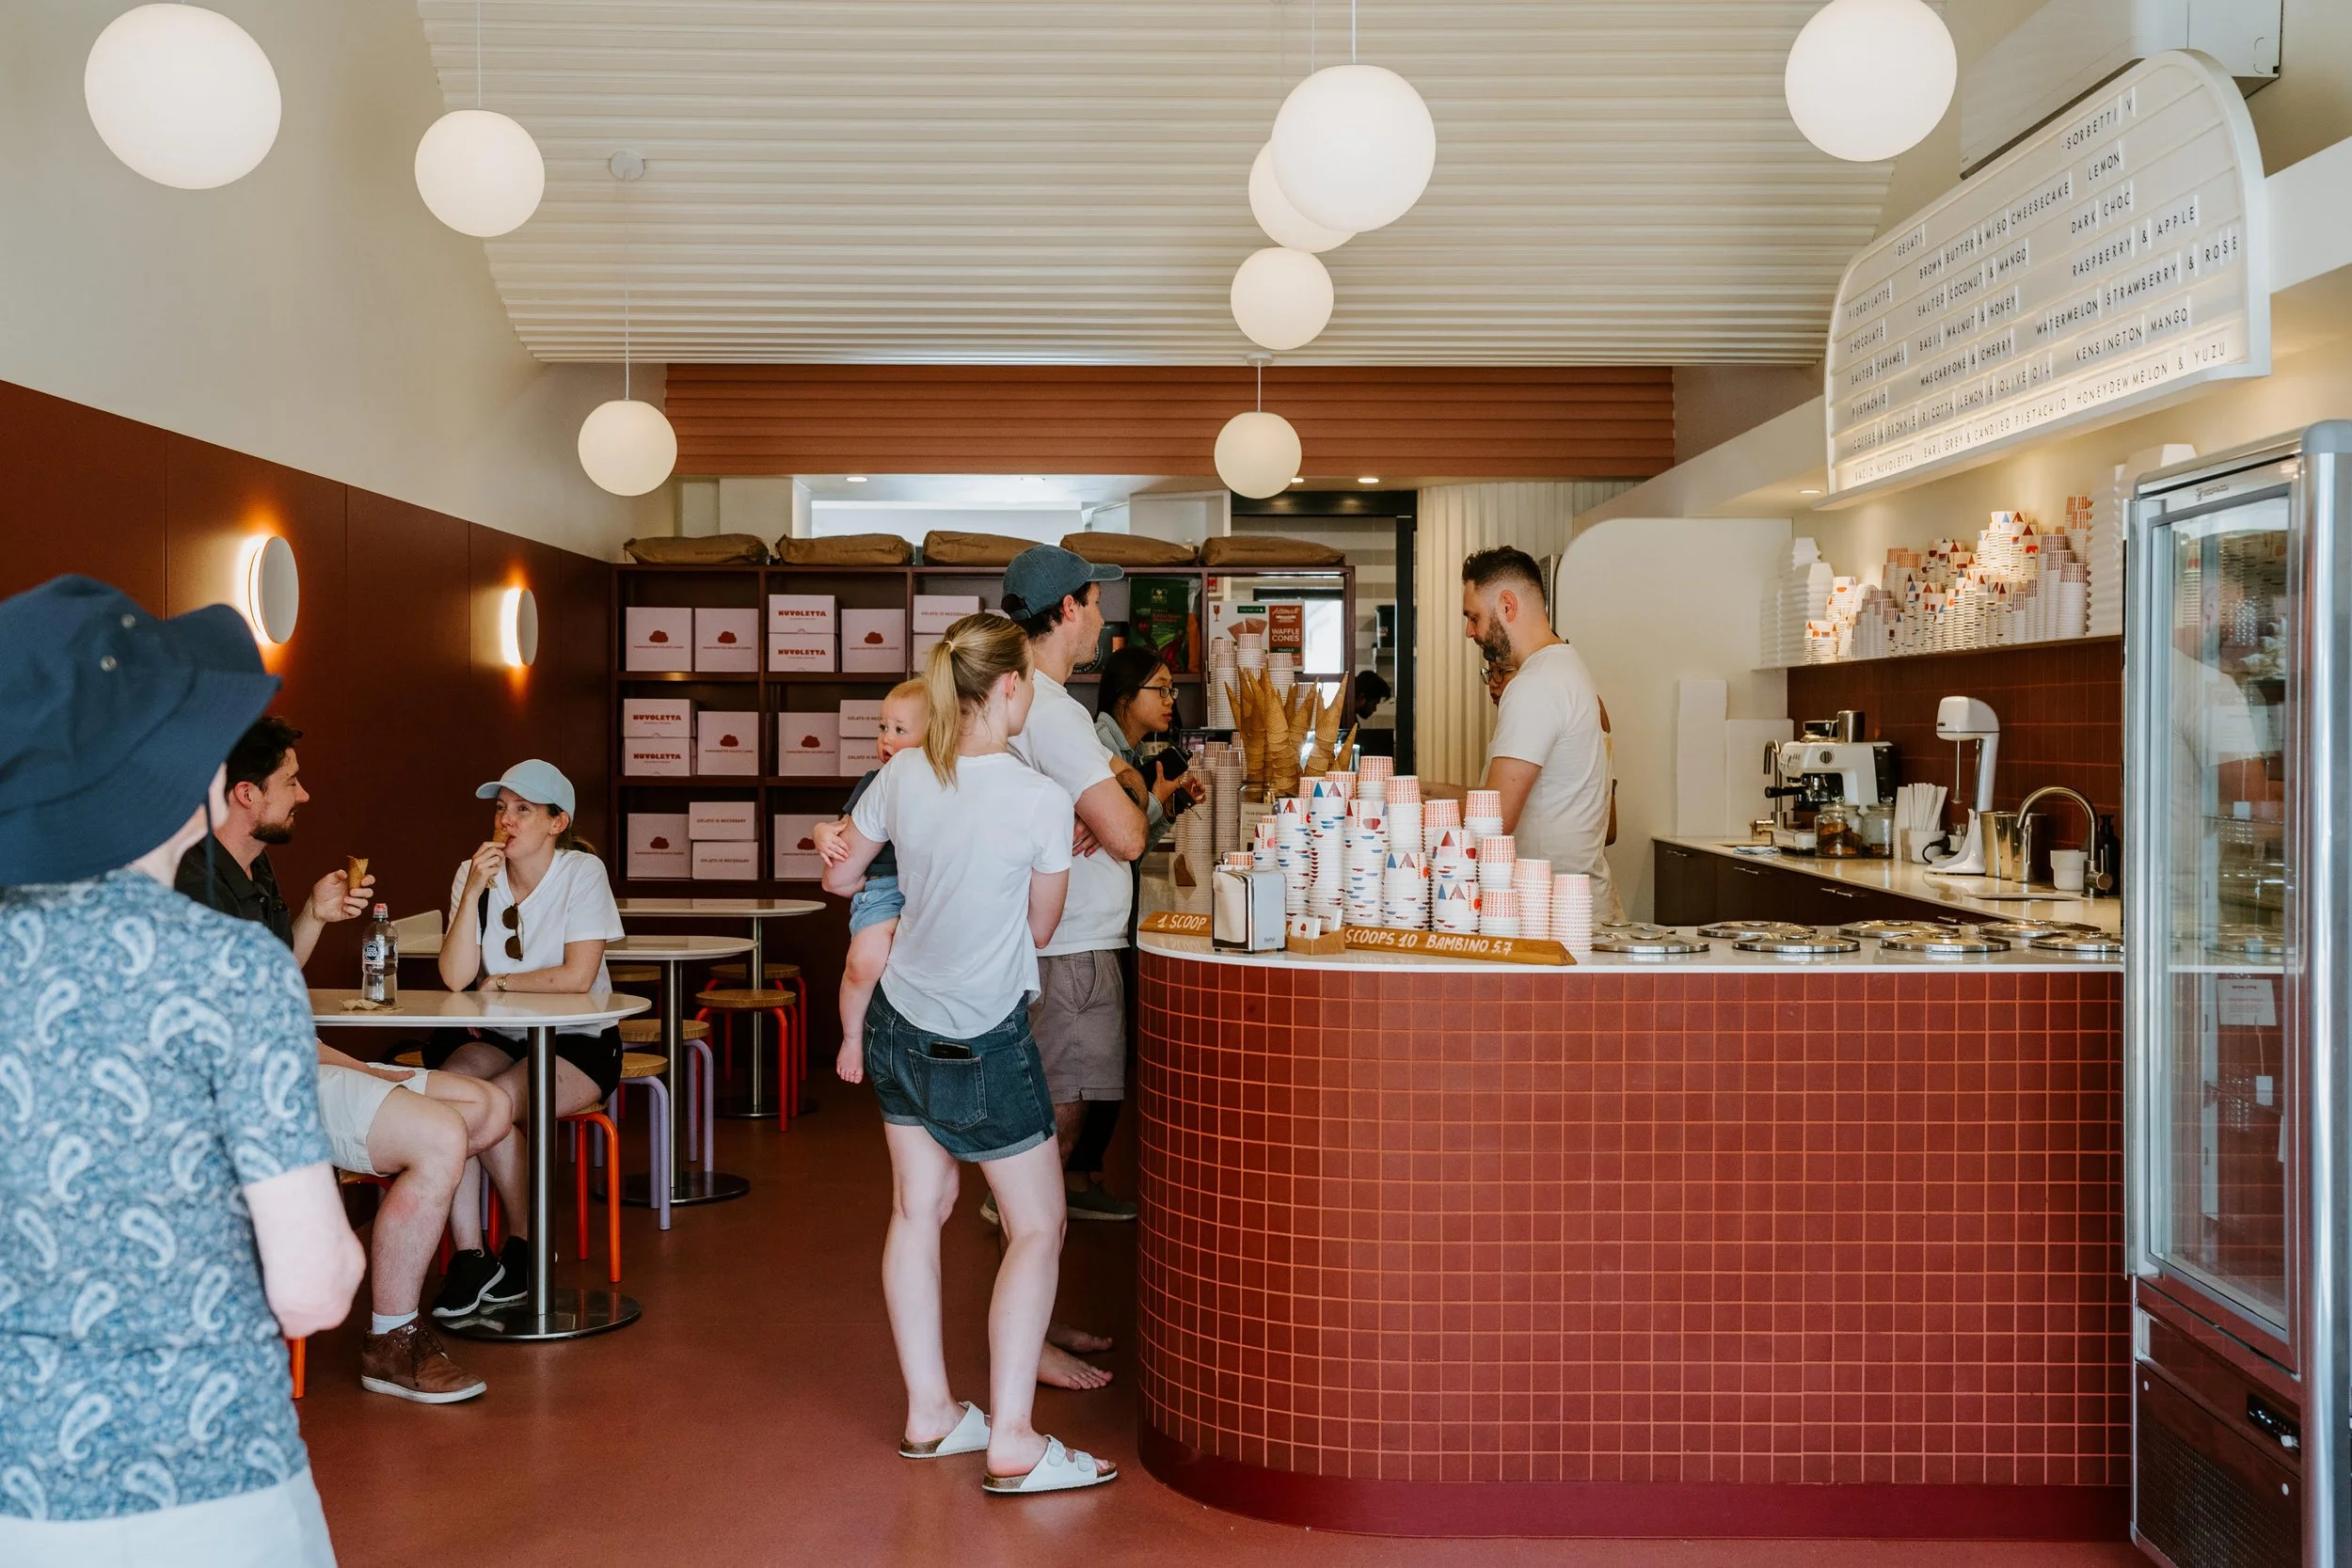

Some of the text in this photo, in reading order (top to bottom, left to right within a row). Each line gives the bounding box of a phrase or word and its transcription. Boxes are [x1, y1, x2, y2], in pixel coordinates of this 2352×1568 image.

[2067, 108, 2117, 150] SORBETTI
[2088, 151, 2121, 181] LEMON
[1919, 257, 1942, 279] BROWN
[1946, 239, 1974, 263] BUTTER
[1985, 218, 2008, 242] MISO
[2010, 182, 2069, 225] CHEESECAKE
[2071, 192, 2131, 234] DARK CHOC
[1898, 232, 1923, 257] GELATI
[2073, 206, 2195, 277] RASPBERRY & APPLE
[1917, 247, 2026, 317] SALTED COCONUT & MANGO
[2035, 236, 2237, 336] WATERMELON STRAWBERRY & ROSE
[1850, 326, 1883, 354] CHOCOLATE
[1919, 332, 1941, 352] BASIL
[1946, 315, 1975, 339] WALNUT
[1990, 294, 2016, 318] HONEY
[2075, 308, 2188, 361] KENSINGTON MANGO
[1851, 351, 1905, 385] SALTED CARAMEL
[1920, 357, 1966, 386] MASCARPONE
[1980, 339, 2011, 361] CHERRY
[2178, 356, 2184, 370] &
[2194, 341, 2225, 364] YUZU
[1851, 393, 1886, 417] PISTACHIO
[1922, 402, 1954, 422] RICOTTA
[1960, 388, 1984, 408] LEMON
[1999, 371, 2026, 392] OLIVE
[2032, 361, 2050, 380] OIL
[1924, 443, 1941, 458] EARL
[1945, 436, 1963, 451] GREY
[1975, 418, 2010, 440] CANDIED
[2015, 398, 2067, 424] PISTACHIO
[1156, 914, 1207, 931] 1 SCOOP
[1344, 928, 1418, 948] SCOOPS 10
[1425, 935, 1489, 954] BAMBINO
